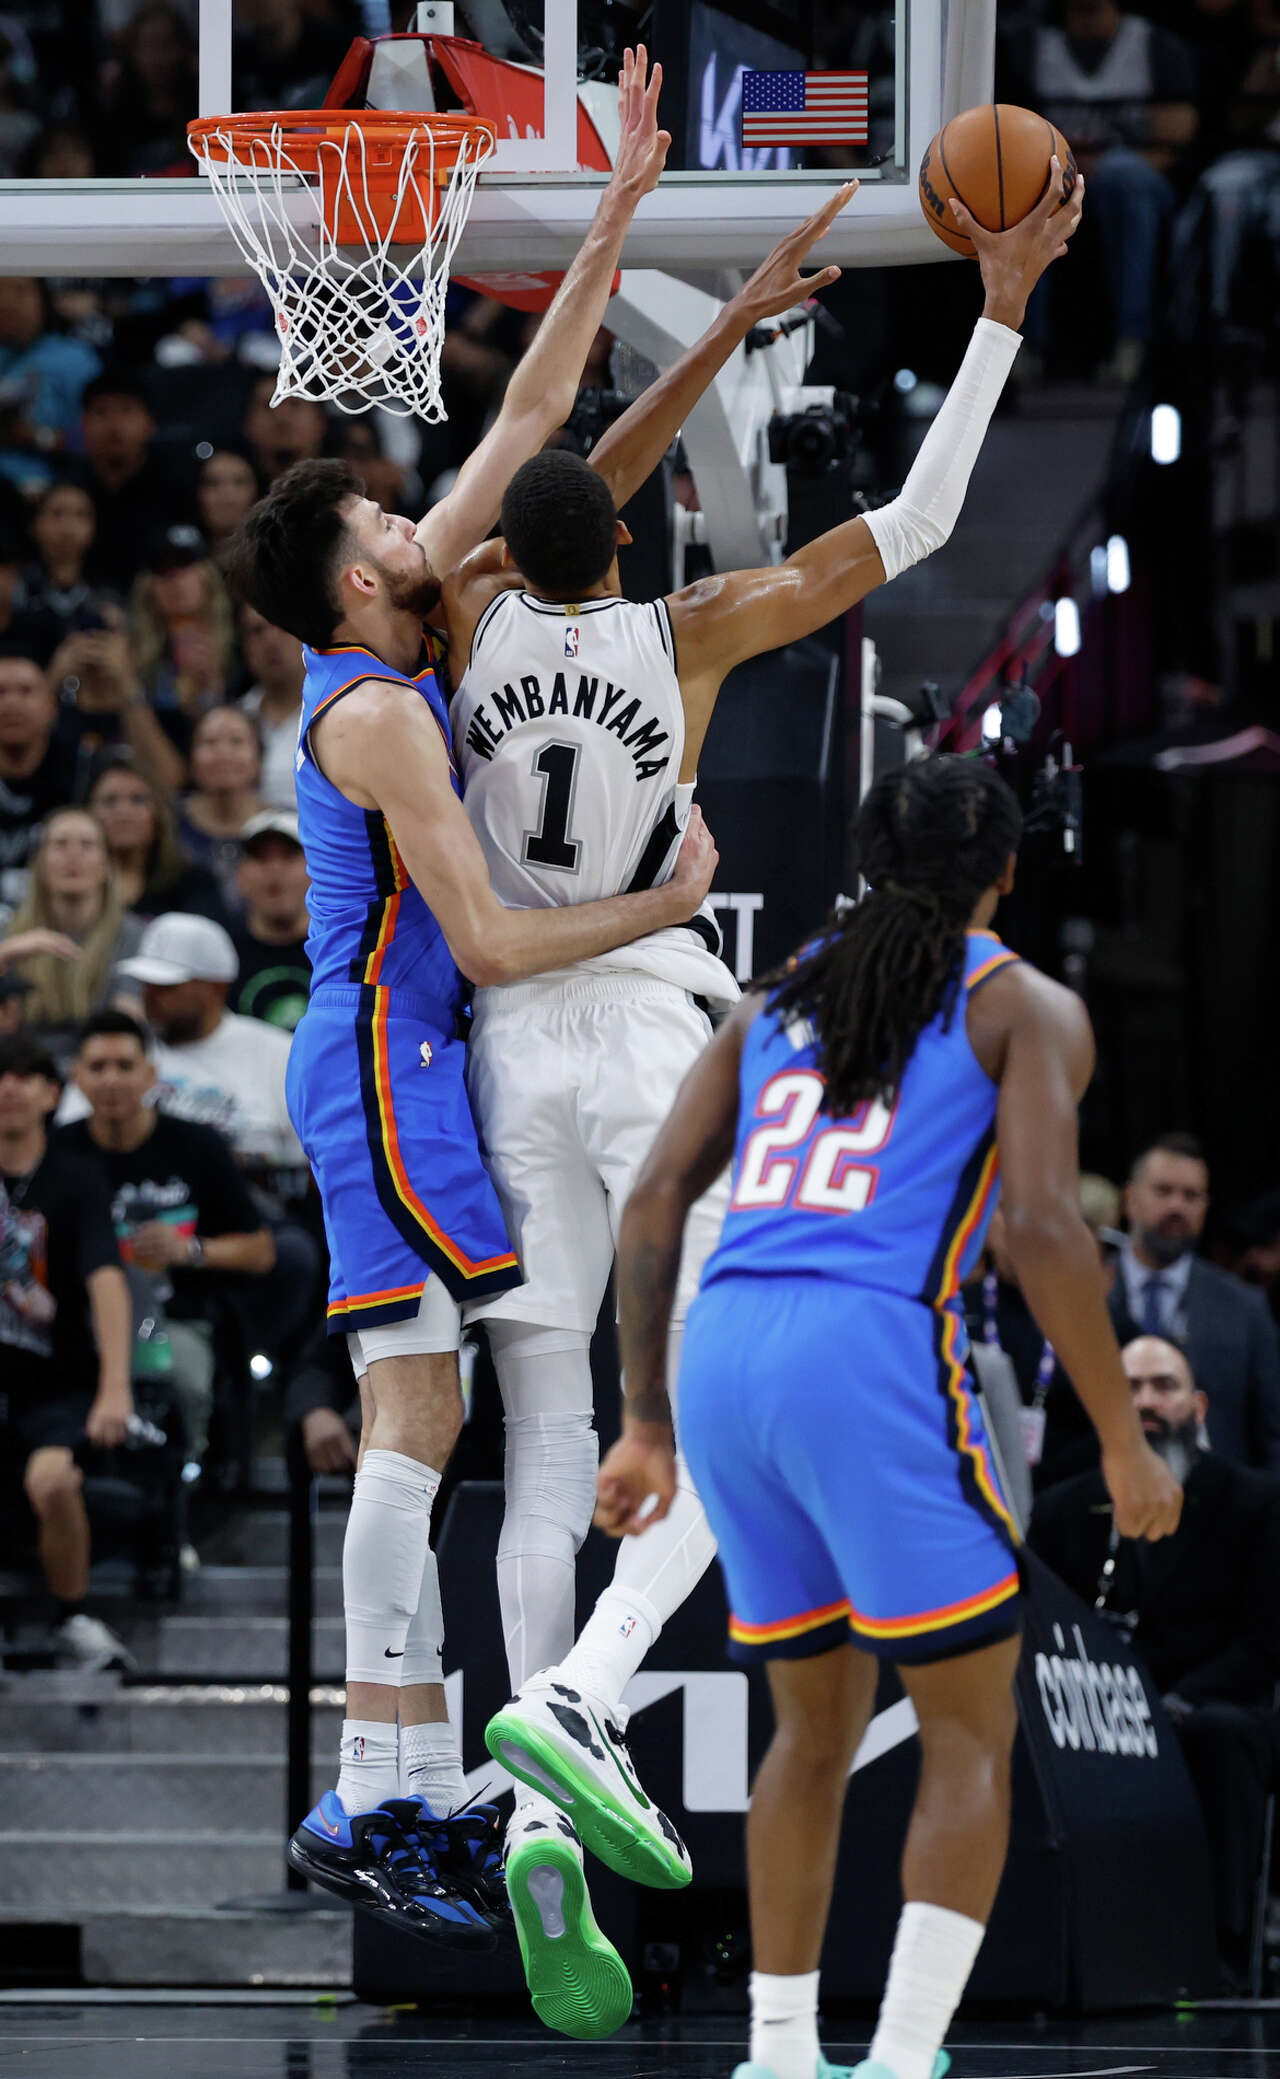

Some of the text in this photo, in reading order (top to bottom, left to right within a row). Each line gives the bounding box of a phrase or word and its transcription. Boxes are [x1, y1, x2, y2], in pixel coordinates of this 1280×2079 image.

[466, 672, 670, 782] WEMBANYAMA
[520, 737, 583, 876] 1
[730, 1068, 903, 1216] 22
[1035, 1621, 1159, 1759] coinbase
